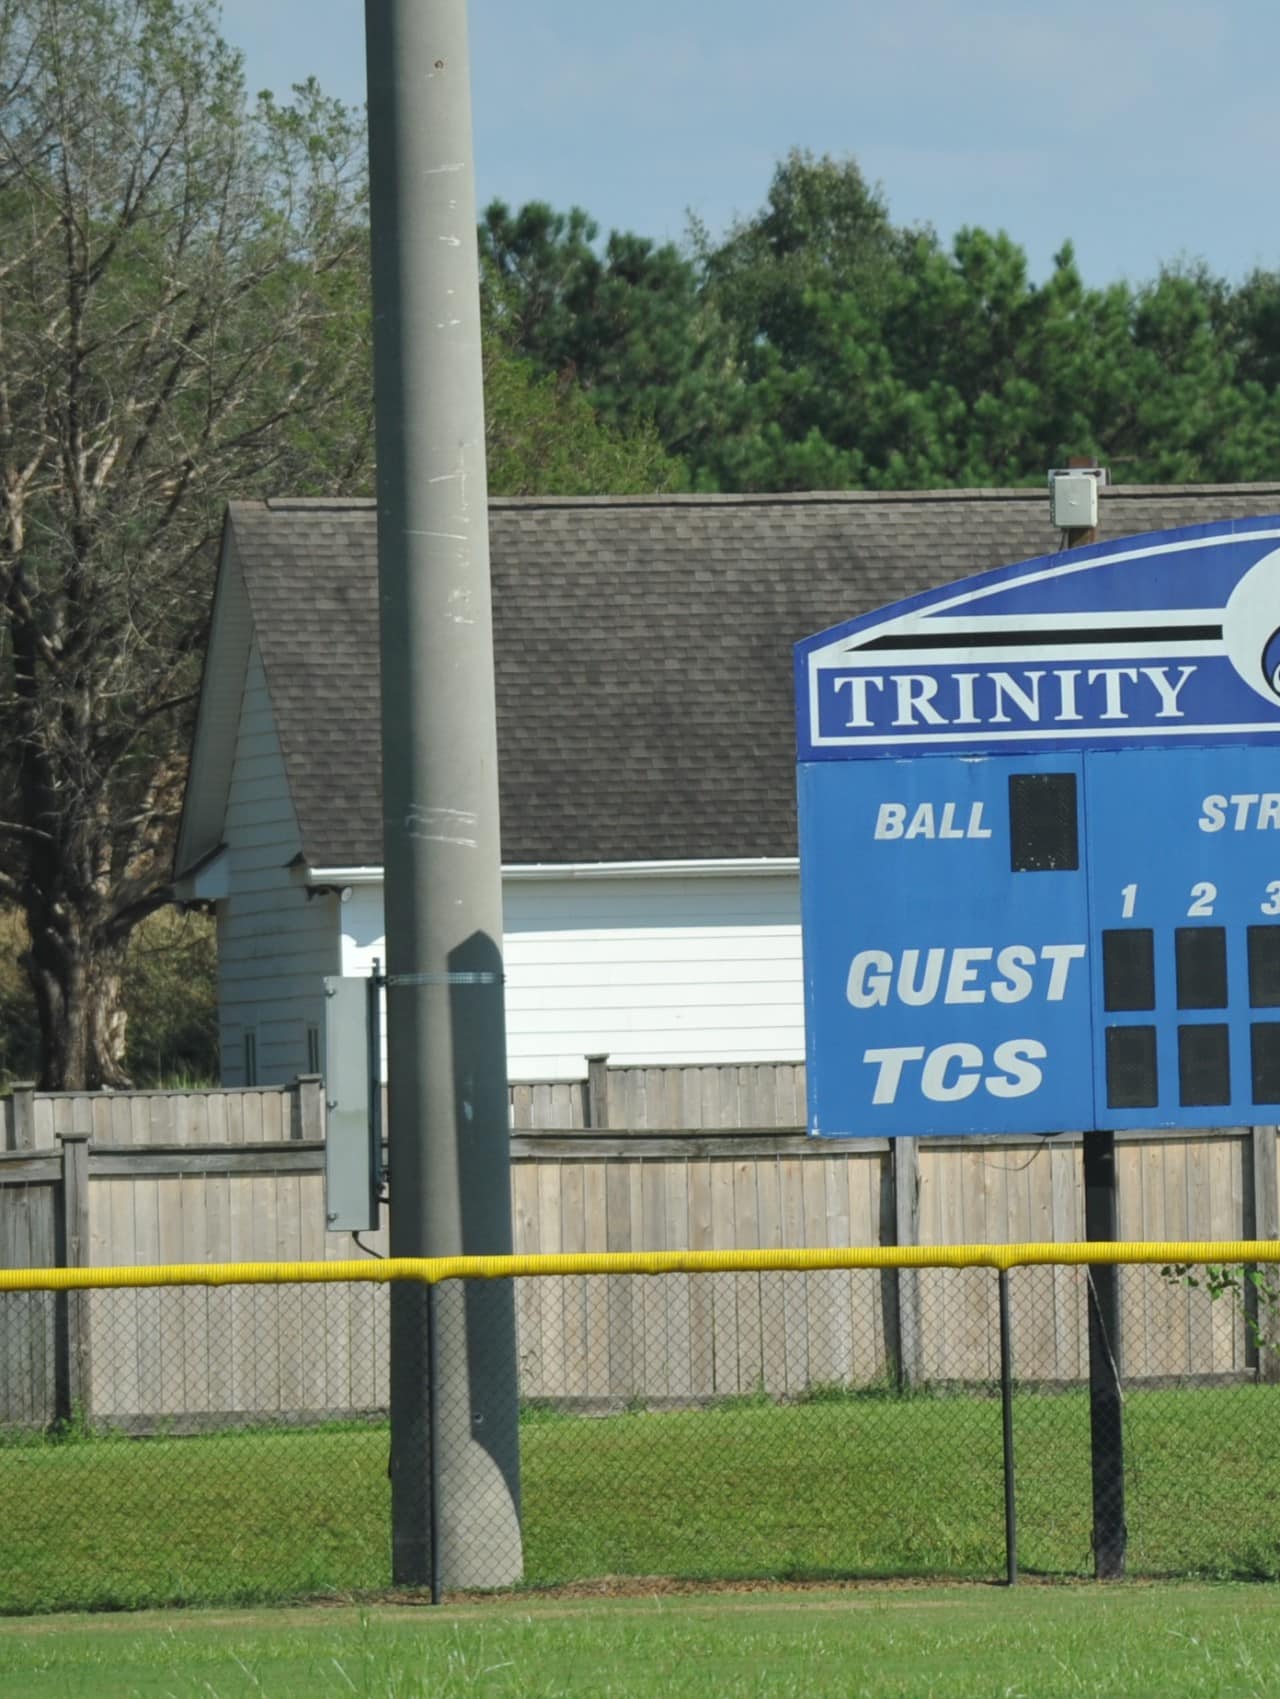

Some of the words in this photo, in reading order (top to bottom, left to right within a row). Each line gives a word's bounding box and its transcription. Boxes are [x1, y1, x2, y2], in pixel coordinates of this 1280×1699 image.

[833, 665, 1198, 728] TRINITY
[874, 801, 993, 840] BALL
[1121, 883, 1138, 918] 1
[1187, 881, 1217, 916] 2
[845, 943, 1086, 1009] GUEST
[862, 1038, 1048, 1104] TCS
